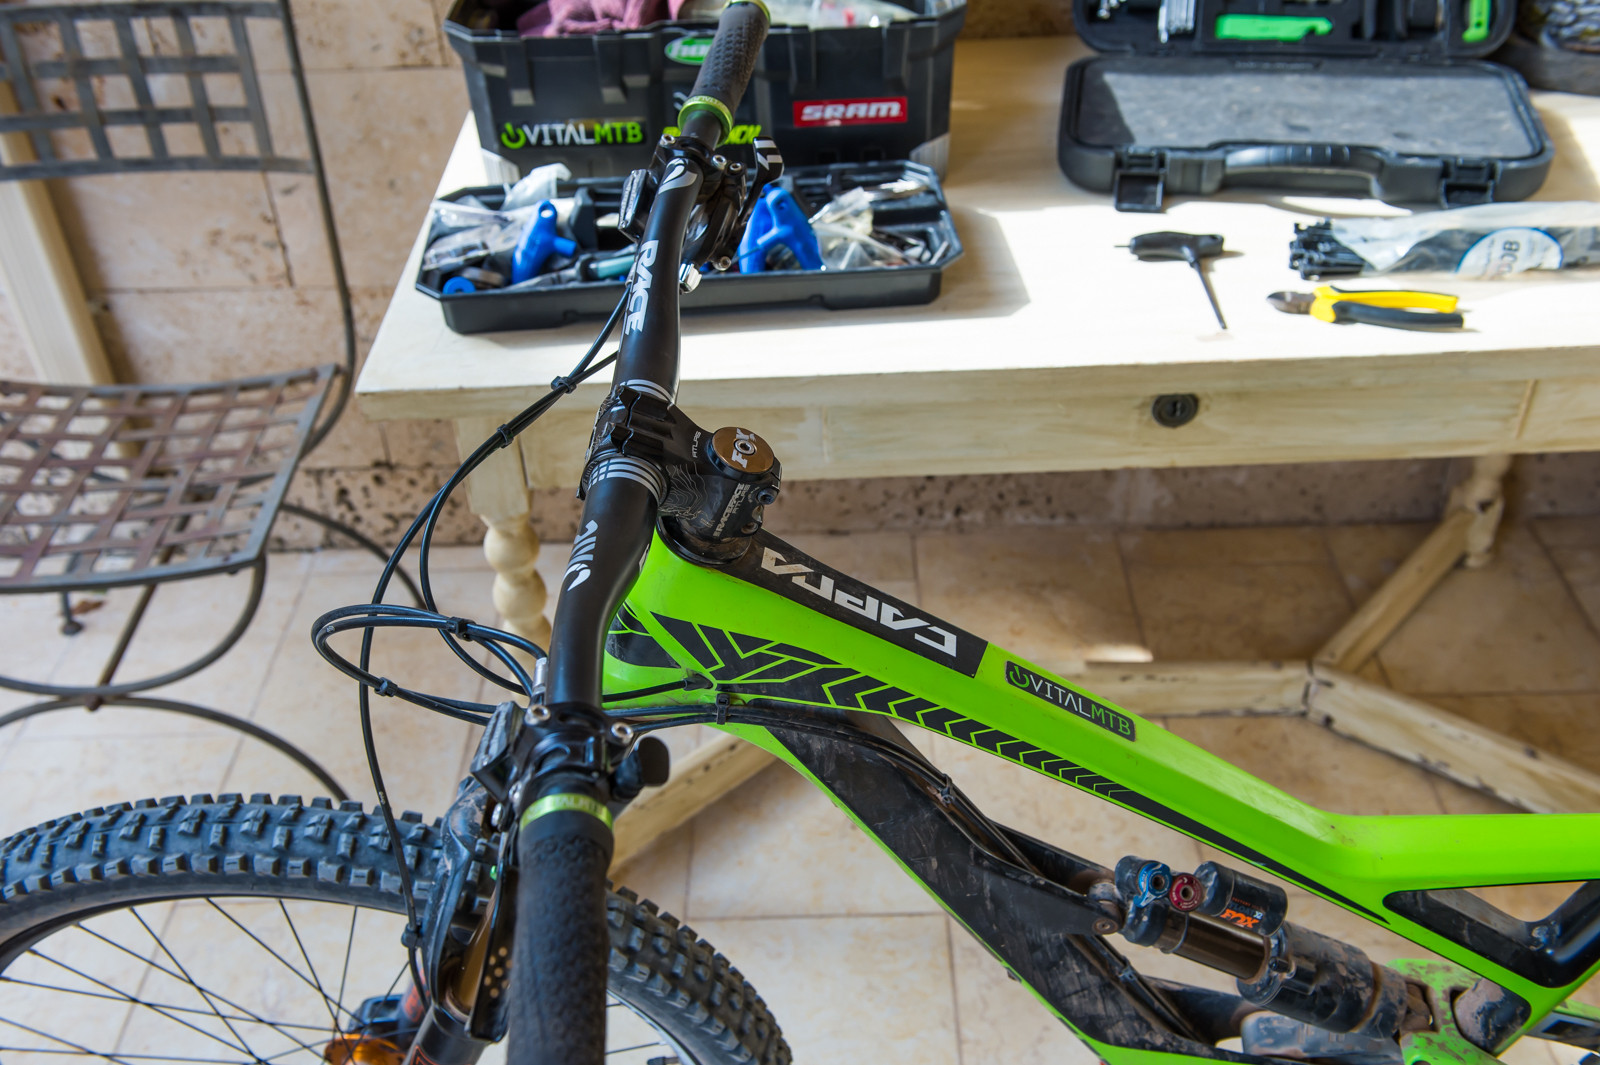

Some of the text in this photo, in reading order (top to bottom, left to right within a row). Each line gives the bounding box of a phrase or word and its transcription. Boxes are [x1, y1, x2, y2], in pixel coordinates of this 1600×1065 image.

[522, 121, 643, 146] VITALMTB
[801, 101, 902, 121] SRAM
[624, 239, 659, 336] RACE
[731, 427, 757, 469] FX
[714, 482, 746, 533] RACEFACE
[761, 546, 957, 658] CAPRA
[1029, 674, 1132, 736] VITALMTB
[1220, 908, 1260, 928] FOX
